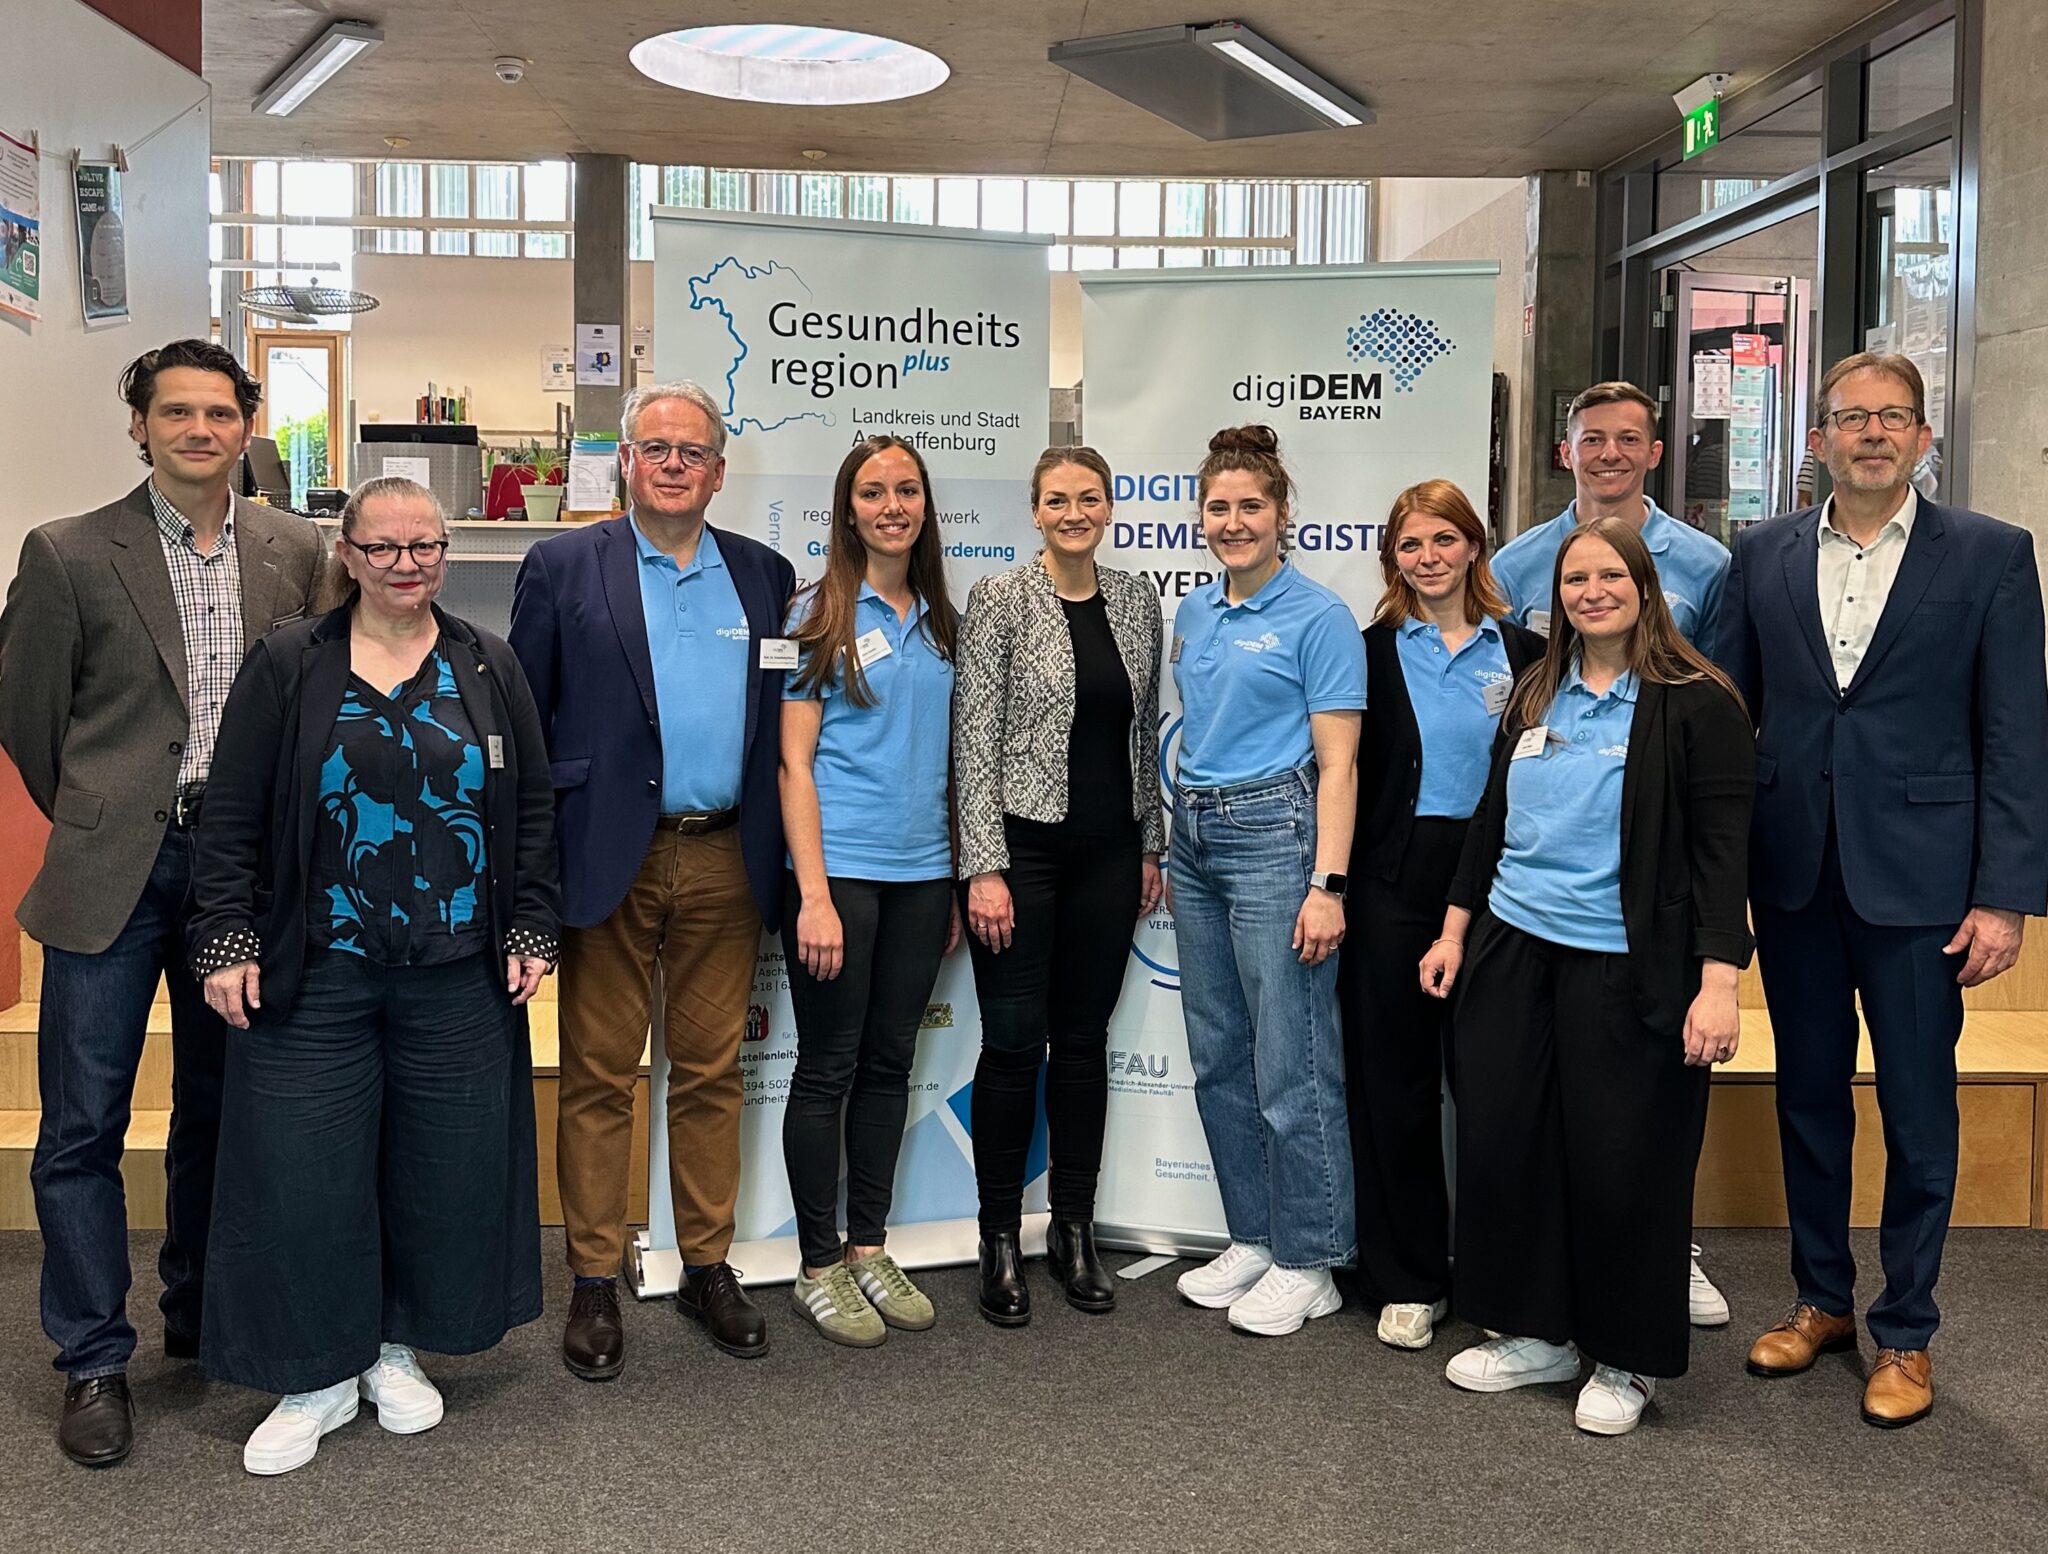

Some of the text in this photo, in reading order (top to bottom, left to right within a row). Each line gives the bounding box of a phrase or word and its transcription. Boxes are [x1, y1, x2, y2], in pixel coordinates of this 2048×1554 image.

[79, 187, 105, 197] ESCAPE
[768, 301, 1020, 348] Gesundheits
[771, 349, 950, 398] region plus
[1232, 373, 1382, 408] digiDEM
[852, 407, 1020, 428] Landkreis und Stadt
[1299, 405, 1382, 420] BAYERN
[1109, 1051, 1169, 1078] FAU
[744, 1079, 792, 1091] 394-502
[1155, 1157, 1211, 1171] Bayerisches
[1155, 1168, 1210, 1182] Gesundheit,
